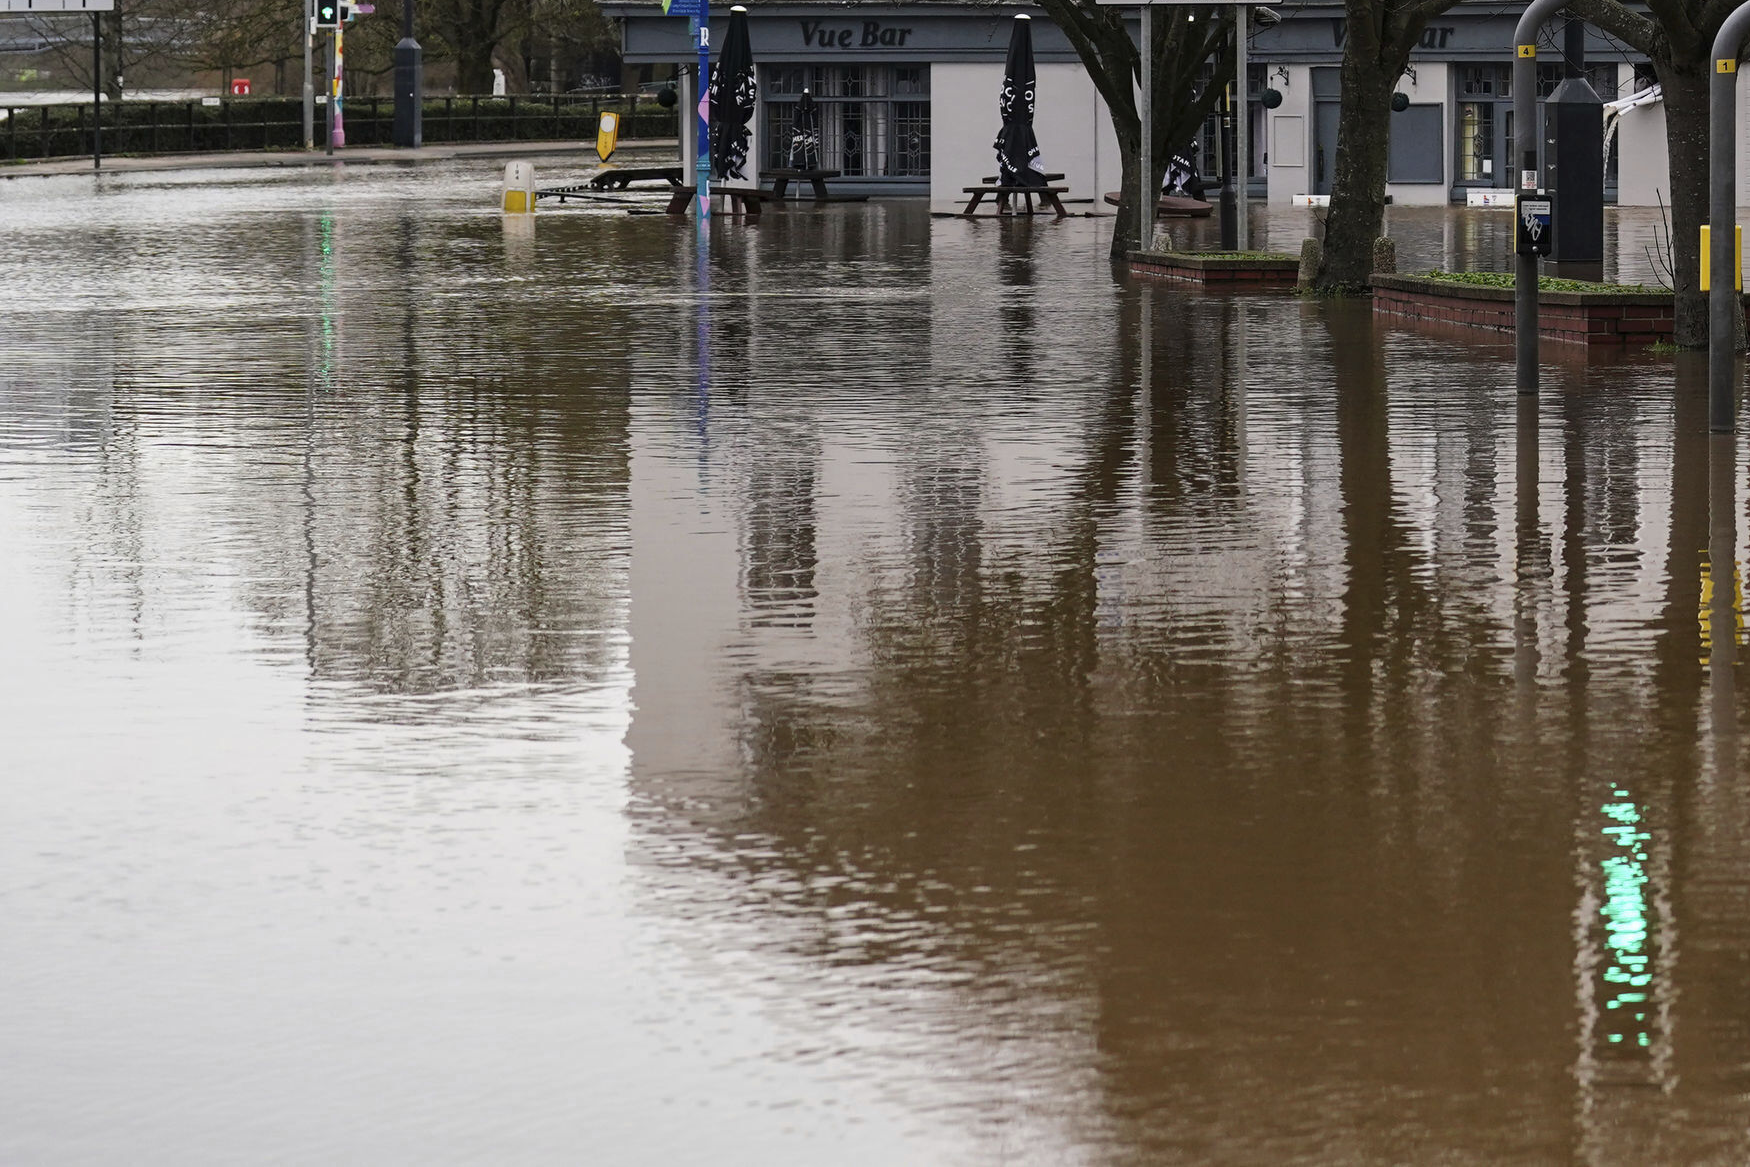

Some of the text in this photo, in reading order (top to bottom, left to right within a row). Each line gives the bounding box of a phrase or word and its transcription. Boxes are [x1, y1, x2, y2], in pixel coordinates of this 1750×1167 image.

[800, 20, 912, 47] Vue Bar
[1523, 47, 1529, 55] 4
